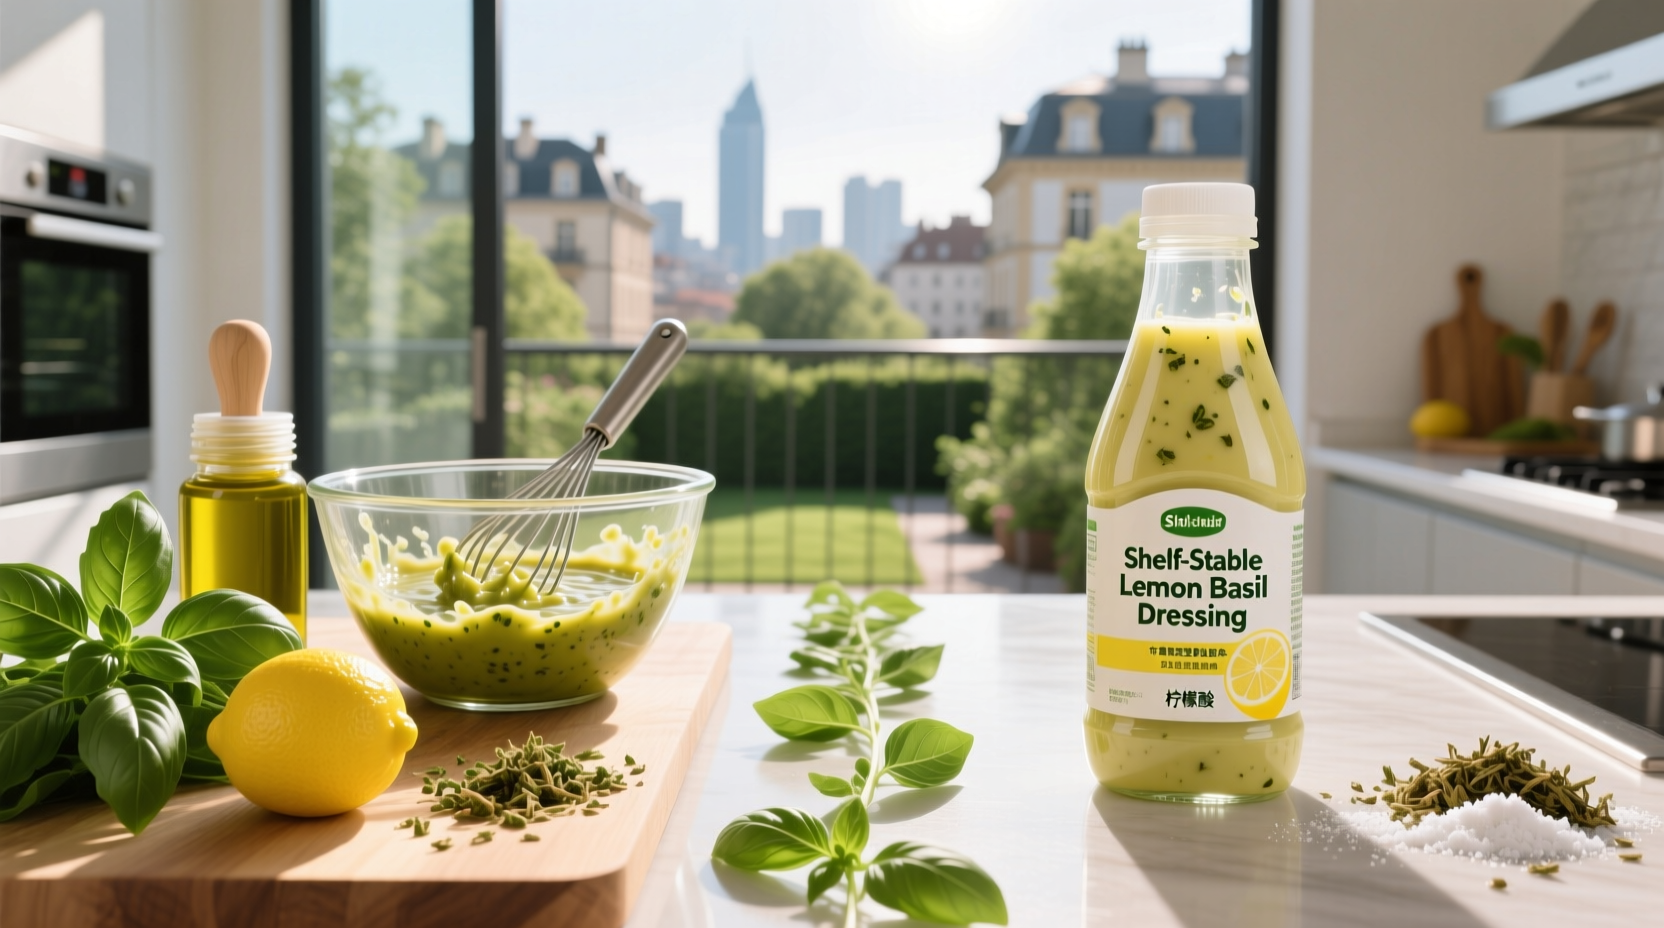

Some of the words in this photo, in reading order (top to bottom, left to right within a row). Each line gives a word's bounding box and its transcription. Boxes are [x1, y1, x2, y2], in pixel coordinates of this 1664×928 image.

[1124, 546, 1263, 571] Shelf-Stable
[1120, 573, 1202, 599] Lemon
[1210, 574, 1268, 599] Basil
[1138, 602, 1247, 633] Dressing
